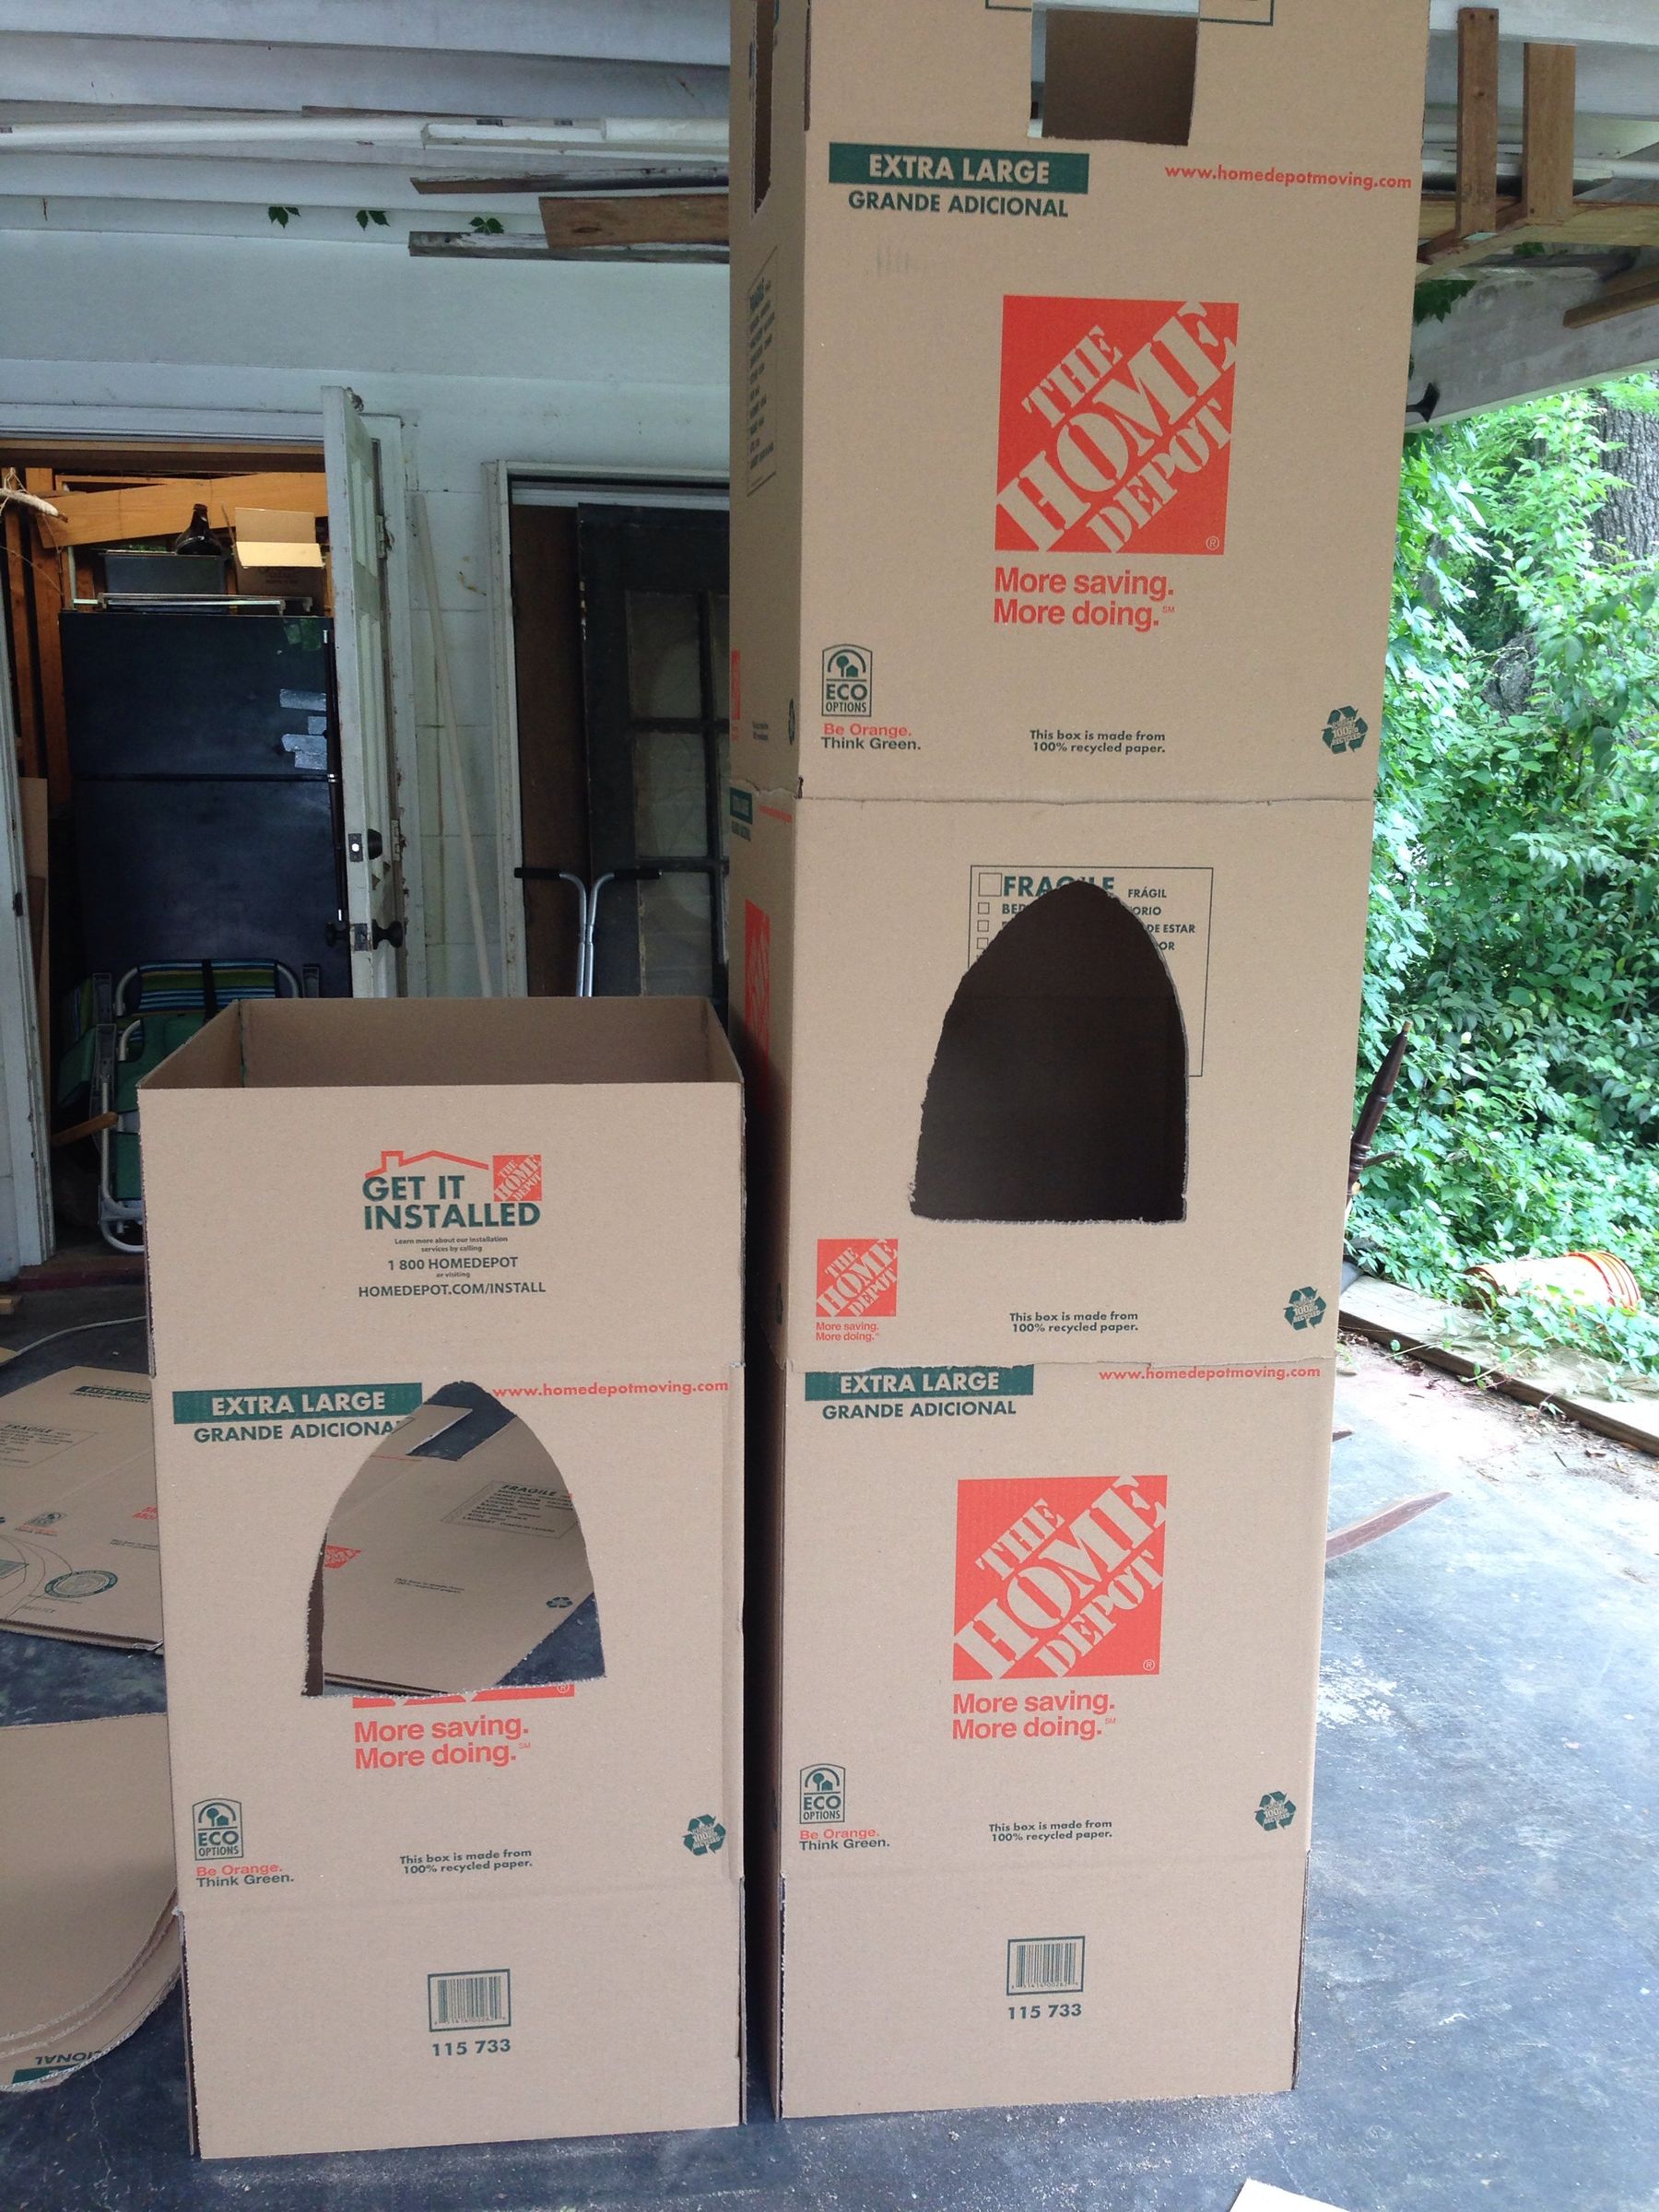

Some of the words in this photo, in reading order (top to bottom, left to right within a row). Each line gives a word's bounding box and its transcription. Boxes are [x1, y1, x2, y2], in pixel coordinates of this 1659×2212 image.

[869, 153, 954, 181] EXTRA
[962, 157, 1050, 184] LARGE
[1164, 163, 1412, 191] www.homedepotmoving.com
[848, 190, 941, 213] GRANDE
[947, 195, 1069, 218] ADICIONAL
[1021, 324, 1124, 428] THE
[995, 300, 1238, 553] HOME
[1086, 397, 1231, 553] DEPOT
[994, 567, 1066, 594] More
[1074, 570, 1174, 601] saving.
[994, 598, 1065, 625] More
[1072, 600, 1159, 632] doing.
[826, 683, 868, 700] ECO
[825, 701, 867, 713] OPTIONS
[824, 723, 845, 735] Be
[850, 723, 912, 738] Orange.
[1029, 729, 1053, 740] This
[1057, 730, 1081, 740] box
[1085, 730, 1094, 740] is
[1097, 730, 1132, 741] made
[1135, 730, 1166, 741] from
[820, 736, 865, 749] Think
[869, 737, 922, 750] Green.
[1033, 742, 1067, 752] 100%
[1070, 742, 1122, 755] recycled
[1125, 743, 1166, 755] paper.
[1128, 886, 1167, 898] FRÁGIL
[1147, 924, 1160, 933] DE
[1163, 924, 1195, 934] ESTAR
[494, 1155, 541, 1201] HOME
[512, 1171, 541, 1201] DEPOT
[362, 1176, 426, 1202] GET
[439, 1175, 465, 1200] IT
[364, 1202, 541, 1230] INSTALLED
[388, 1260, 394, 1271] 1
[399, 1259, 425, 1270] 800
[429, 1256, 518, 1270] HOMEDEPOT
[825, 1247, 858, 1278] THE
[817, 1239, 897, 1317] HOME
[359, 1282, 547, 1298] HOMEDEPOT.COM/INSTALL
[848, 1267, 897, 1317] DEPOT
[1009, 1312, 1032, 1322] This
[1036, 1312, 1058, 1322] box
[1062, 1312, 1070, 1321] is
[1074, 1311, 1107, 1321] made
[1111, 1311, 1138, 1321] from
[816, 1323, 841, 1331] More
[844, 1322, 879, 1332] saving.
[1013, 1323, 1045, 1333] 100%
[1049, 1322, 1097, 1334] recycled
[1100, 1323, 1138, 1334] paper.
[816, 1332, 841, 1341] More
[843, 1332, 875, 1342] doing.
[1099, 1365, 1321, 1382] www.homedepotmoving.com
[492, 1381, 728, 1397] www.homedepotmoving.com
[840, 1373, 916, 1394] EXTRA
[923, 1371, 1000, 1393] LARGE
[212, 1395, 295, 1417] EXTRA
[302, 1392, 385, 1413] LARGE
[822, 1403, 903, 1419] GRANDE
[910, 1401, 1017, 1418] ADICIONAL
[194, 1425, 283, 1443] GRANDE
[291, 1420, 400, 1440] ADICIONA
[502, 1484, 558, 1497] FRAGILE
[975, 1498, 1065, 1581] THE
[953, 1475, 1167, 1679] HOME
[1034, 1549, 1164, 1677] DEPOT
[953, 1693, 1018, 1714] More
[1024, 1690, 1115, 1715] saving.
[354, 1721, 425, 1743] More
[431, 1714, 529, 1740] saving.
[953, 1718, 1017, 1740] More
[1024, 1716, 1102, 1741] doing.
[355, 1747, 425, 1770] More
[431, 1742, 516, 1767] doing.
[804, 1794, 841, 1810] ECO
[803, 1810, 841, 1820] OPTIONS
[989, 1823, 1010, 1832] This
[1014, 1823, 1035, 1831] box
[1039, 1822, 1047, 1830] is
[1051, 1820, 1082, 1830] made
[1086, 1819, 1112, 1829] from
[198, 1830, 240, 1847] ECO
[800, 1830, 818, 1840] Be
[823, 1829, 879, 1840] Orange.
[992, 1833, 1023, 1841] 100%
[1026, 1830, 1073, 1841] recycled
[1076, 1831, 1112, 1841] paper.
[198, 1846, 240, 1857] OPTIONS
[799, 1840, 839, 1851] Think
[843, 1839, 890, 1849] Green.
[400, 1855, 423, 1865] This
[427, 1854, 450, 1863] box
[453, 1853, 463, 1861] is
[465, 1850, 500, 1861] made
[503, 1849, 532, 1858] from
[196, 1866, 217, 1877] Be
[221, 1864, 283, 1875] Orange.
[404, 1865, 438, 1874] 100%
[441, 1861, 490, 1873] recycled
[493, 1860, 533, 1870] paper.
[195, 1876, 240, 1888] Think
[243, 1874, 294, 1885] Green.
[1008, 2006, 1041, 2019] 115
[1048, 2003, 1082, 2018] 733
[432, 2041, 467, 2056] 115
[475, 2038, 511, 2053] 733
